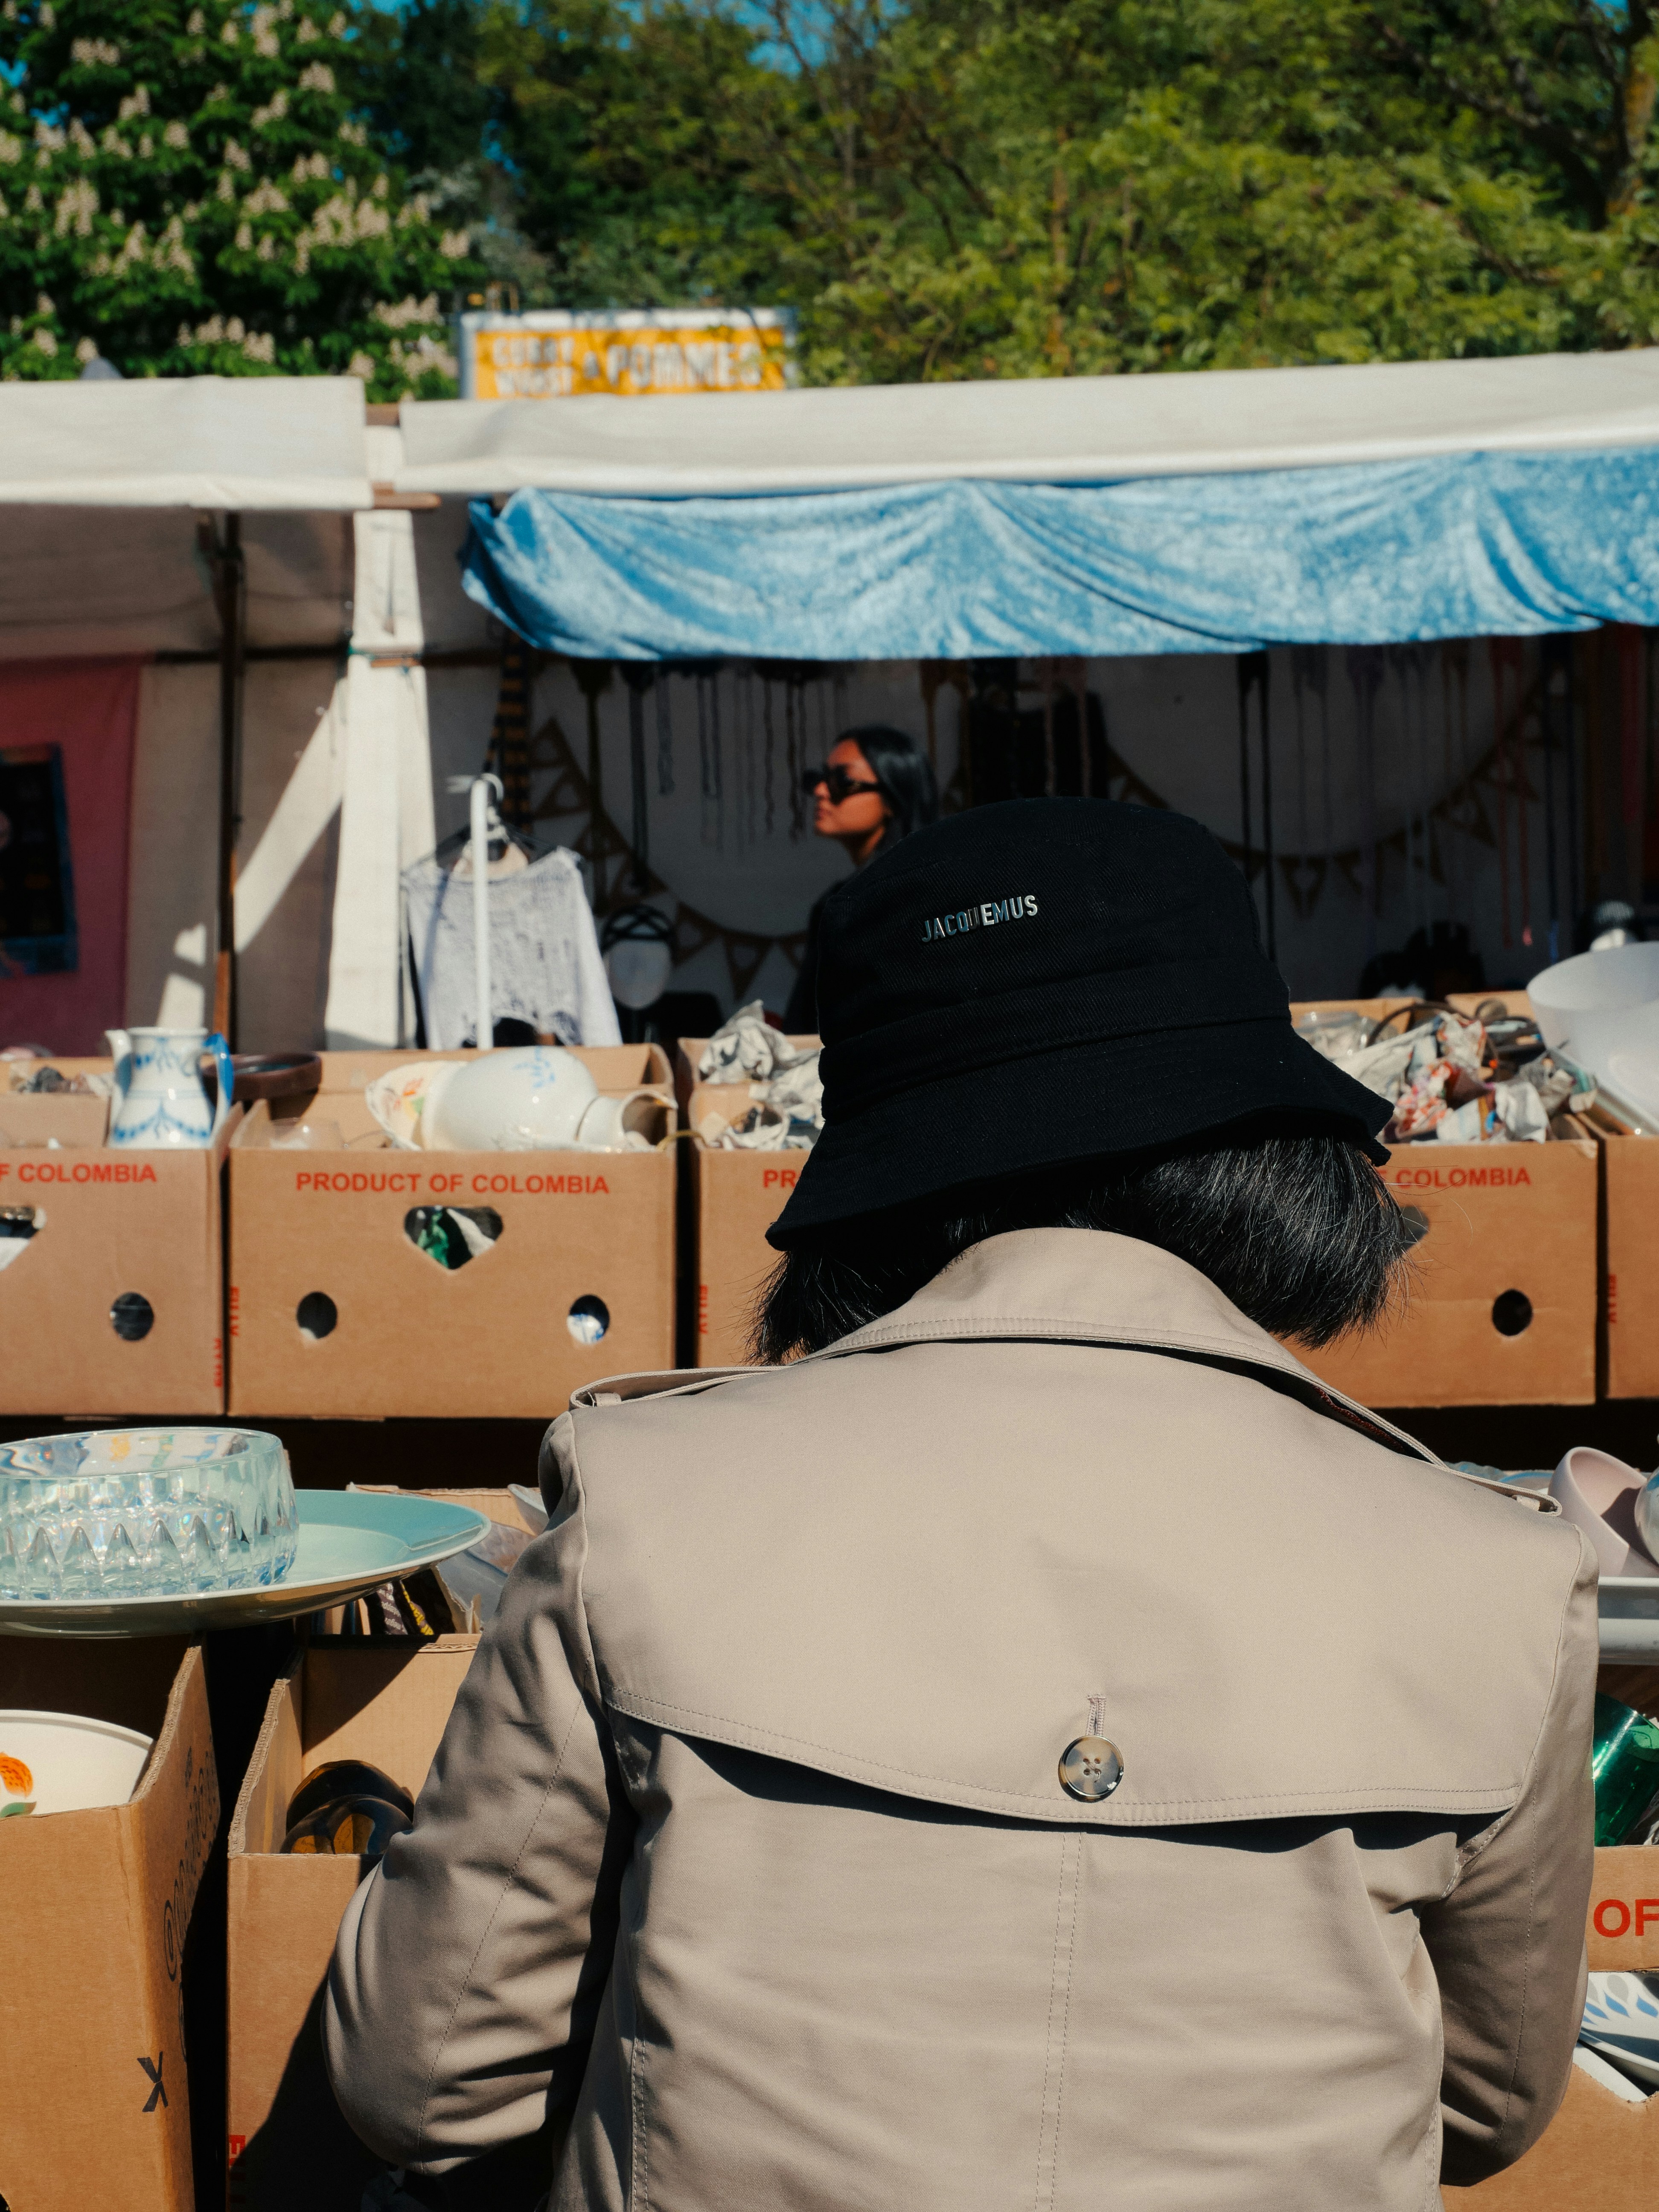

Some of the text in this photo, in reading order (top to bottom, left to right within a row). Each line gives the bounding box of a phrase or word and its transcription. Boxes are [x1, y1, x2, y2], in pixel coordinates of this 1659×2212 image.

[922, 895, 1037, 942] JACQUEMUS
[18, 1163, 157, 1183] COLOMBIA
[296, 1173, 610, 1193] PRODUCT OF COLOMBIA
[763, 1169, 801, 1188] PR
[1396, 1168, 1531, 1188] COLOMBIA
[1593, 1899, 1659, 1938] OF
